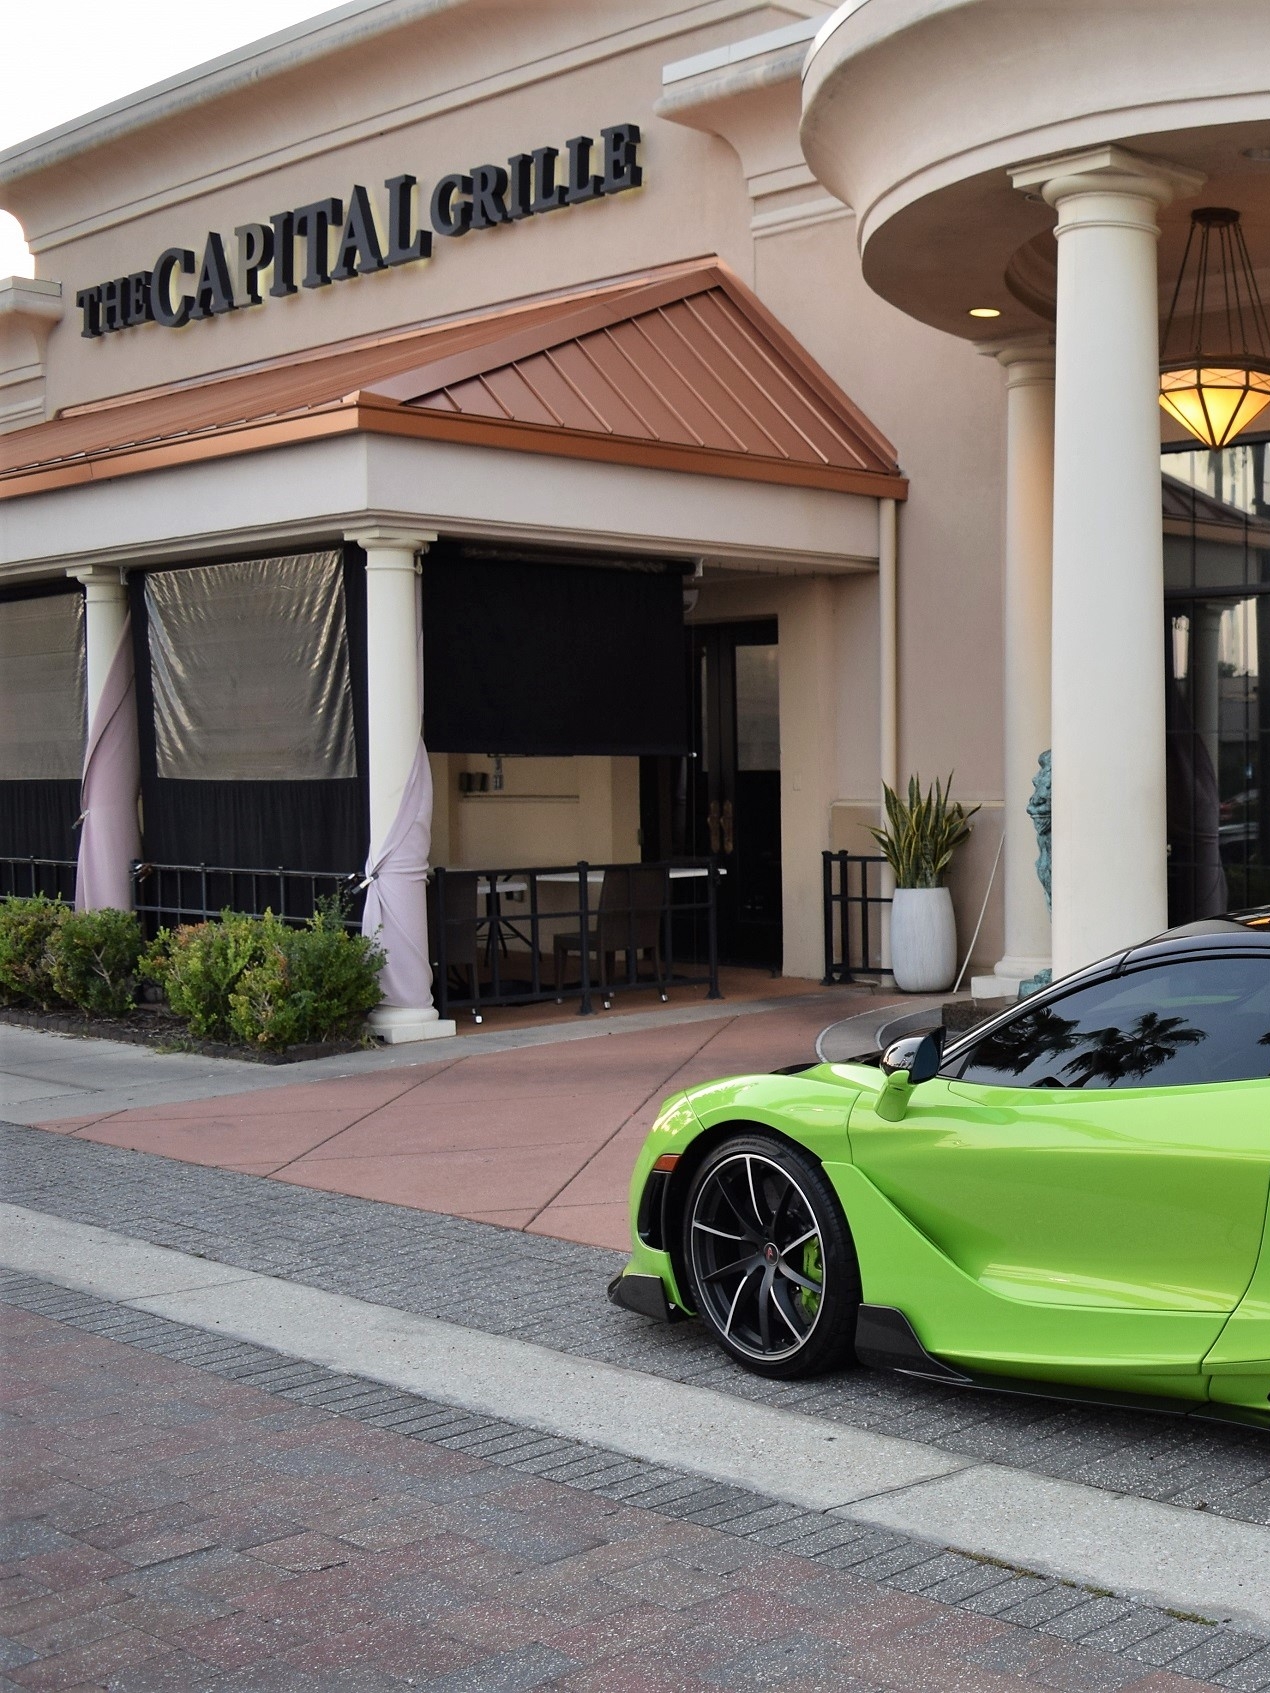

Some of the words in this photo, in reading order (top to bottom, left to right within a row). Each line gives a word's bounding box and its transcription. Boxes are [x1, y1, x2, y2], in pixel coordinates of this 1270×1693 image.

[76, 271, 153, 339] THE
[150, 174, 433, 328] CAPITAL
[430, 123, 643, 237] GRILLE
